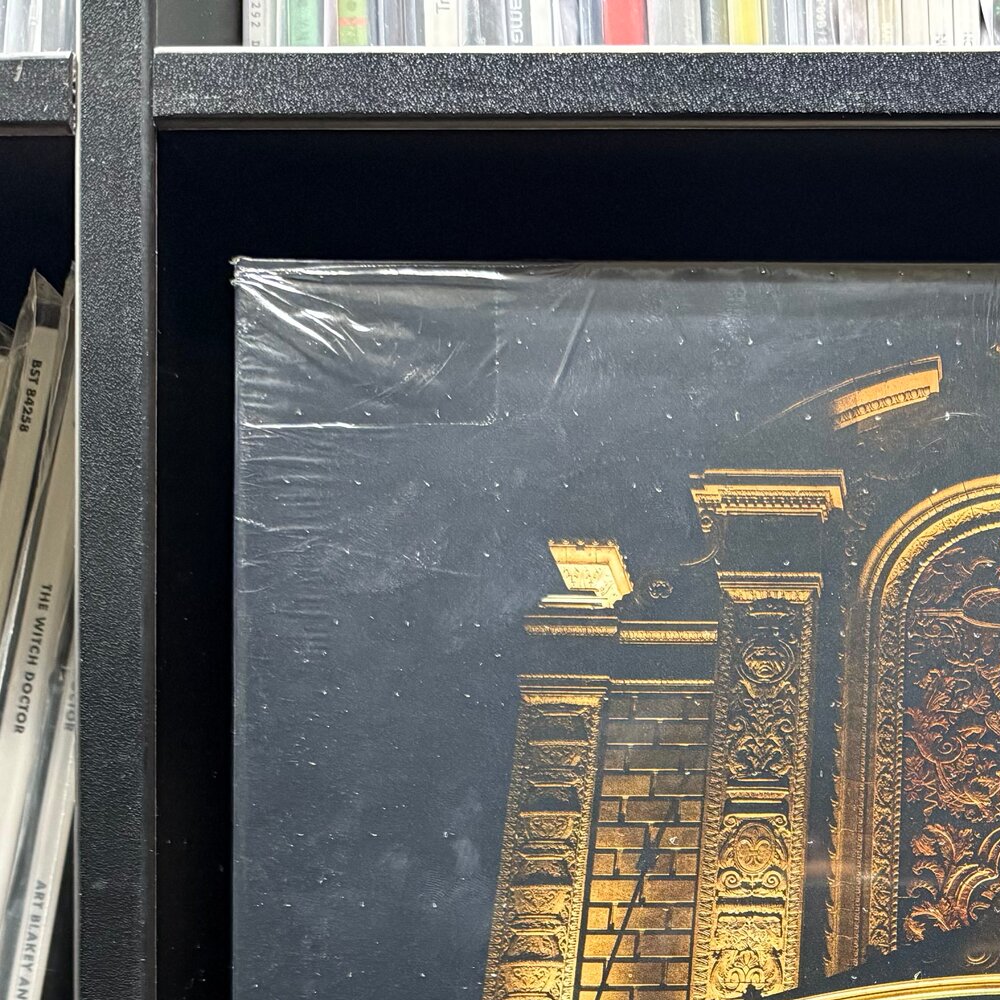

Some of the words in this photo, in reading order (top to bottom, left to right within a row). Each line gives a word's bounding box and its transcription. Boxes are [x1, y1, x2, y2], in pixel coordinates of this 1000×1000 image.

[29, 359, 43, 385] BST
[19, 388, 37, 432] 84258
[38, 584, 53, 611] THE
[26, 617, 47, 666] WITCH
[14, 672, 35, 734] DOCTOR
[33, 879, 47, 909] ART
[21, 914, 42, 973] BLAKEY
